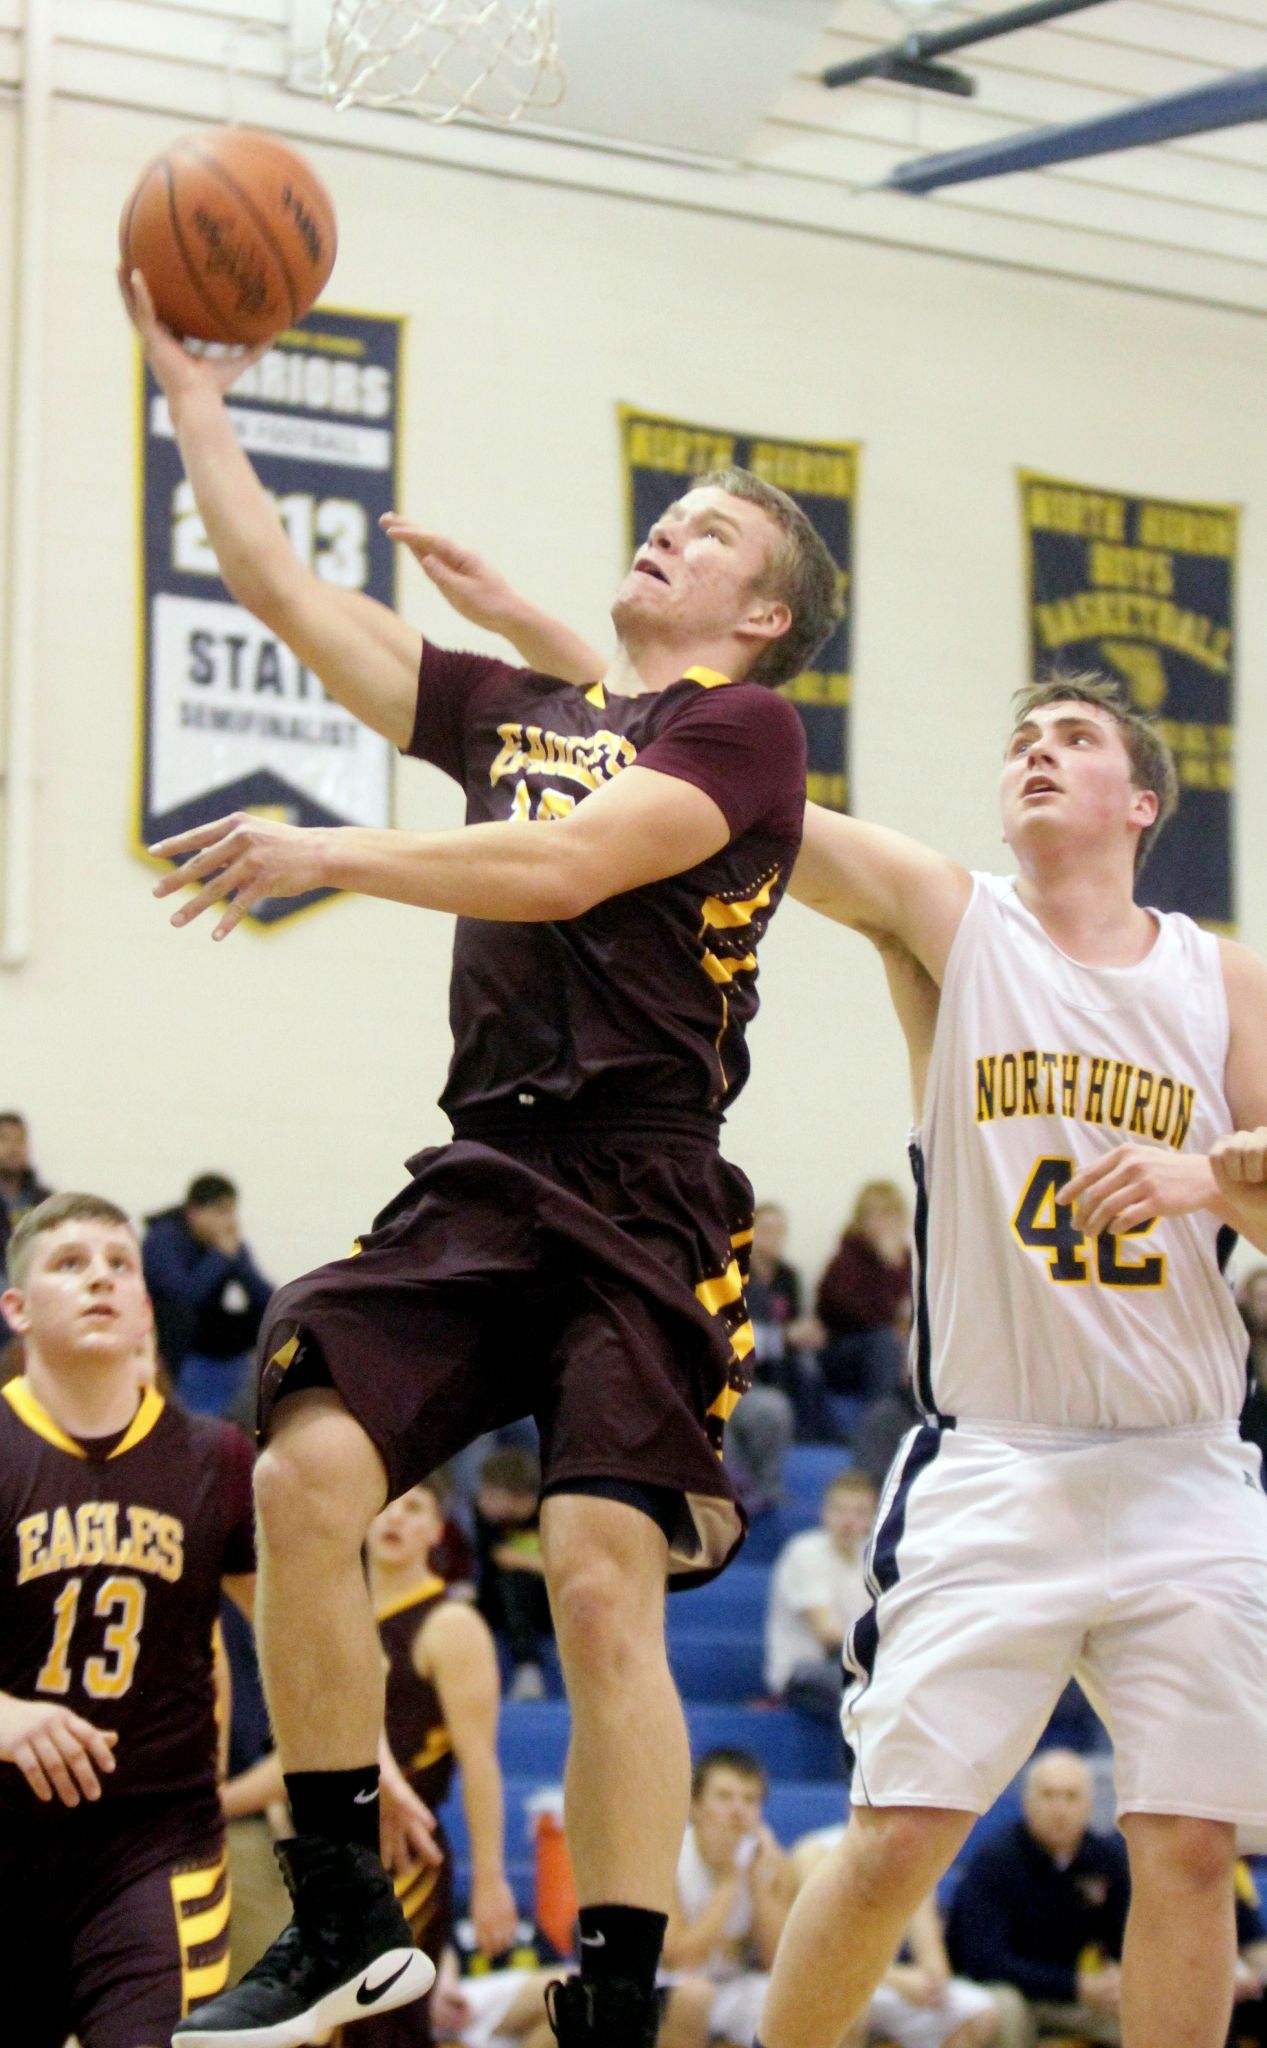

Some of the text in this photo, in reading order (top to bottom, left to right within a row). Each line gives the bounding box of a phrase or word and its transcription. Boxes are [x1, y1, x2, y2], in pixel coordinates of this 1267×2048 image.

[182, 335, 392, 420] RIORS
[173, 481, 368, 590] 213
[188, 628, 335, 702] STA
[975, 1050, 1196, 1150] NORTH HURON
[1010, 1155, 1167, 1290] 42
[16, 1501, 184, 1587] EAGLES
[35, 1575, 147, 1699] 13
